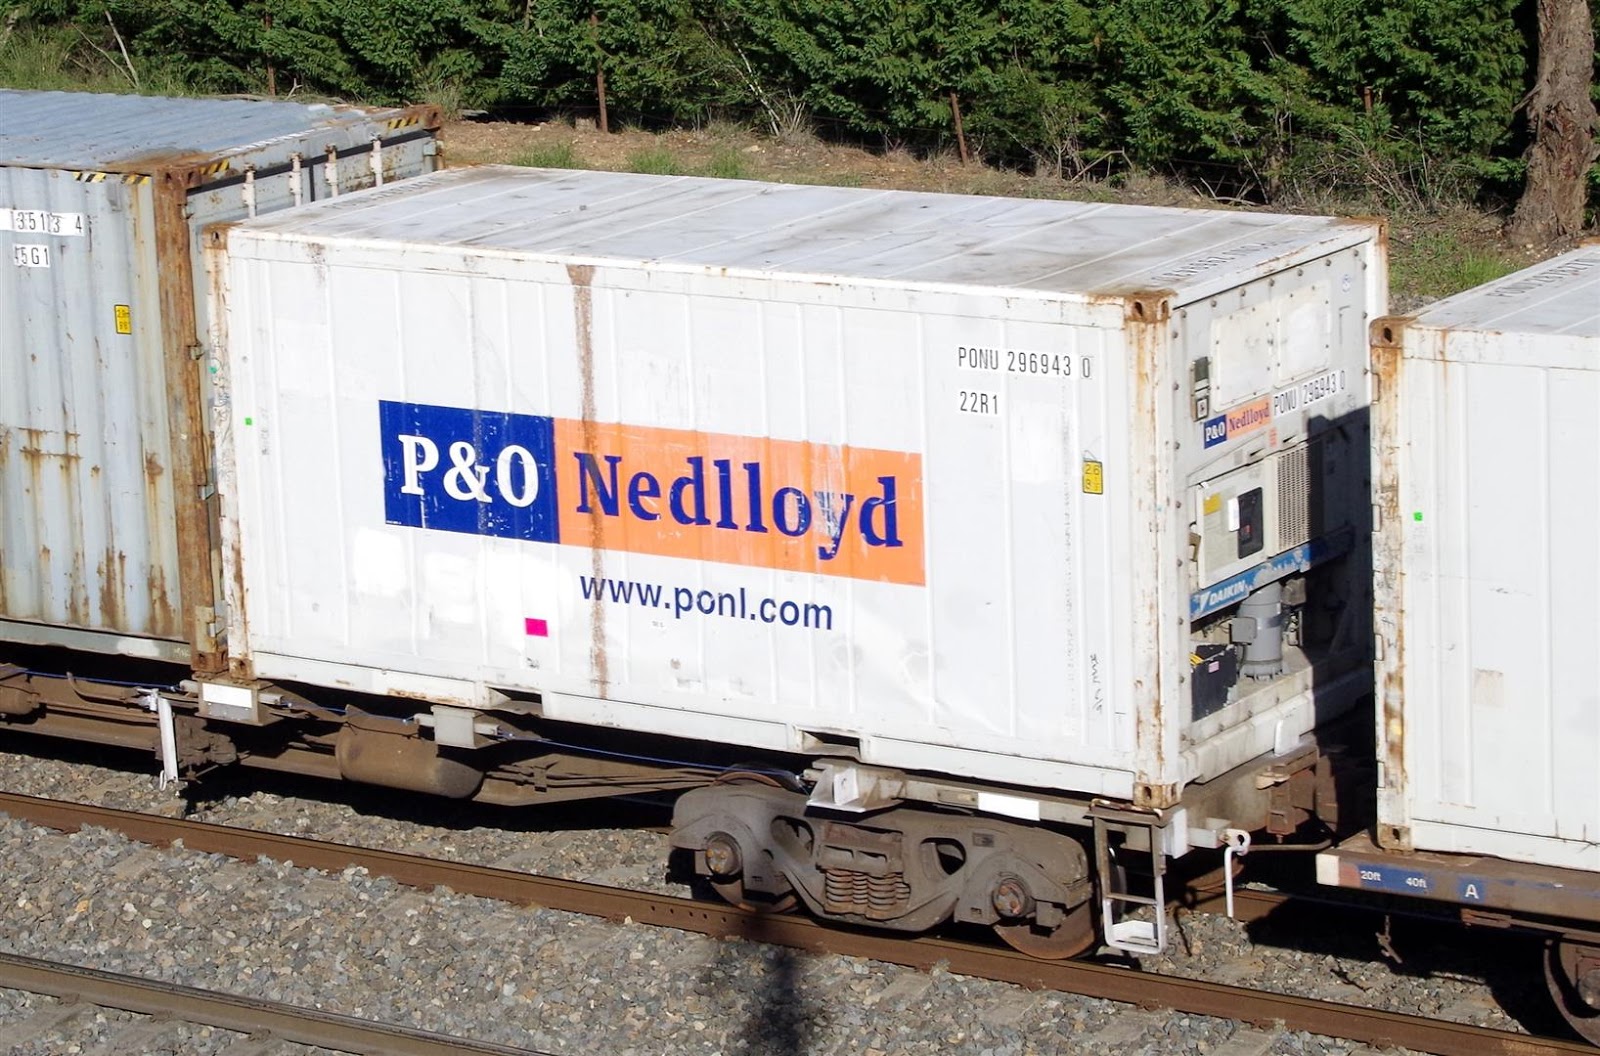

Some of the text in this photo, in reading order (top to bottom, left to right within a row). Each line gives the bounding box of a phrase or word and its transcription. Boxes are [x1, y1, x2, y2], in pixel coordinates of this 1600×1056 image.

[958, 347, 999, 370] PONU
[1007, 351, 1071, 376] 296943
[960, 391, 998, 415] 22R1
[1274, 391, 1297, 416] PONU
[1205, 401, 1270, 441] P&O Nedlloyd
[398, 434, 903, 560] P&O Nedlloyd
[580, 575, 833, 631] www.ponl.com
[1209, 580, 1246, 604] DAIKIN
[1361, 870, 1426, 888] 20ft 40ft
[1465, 884, 1479, 899] A
